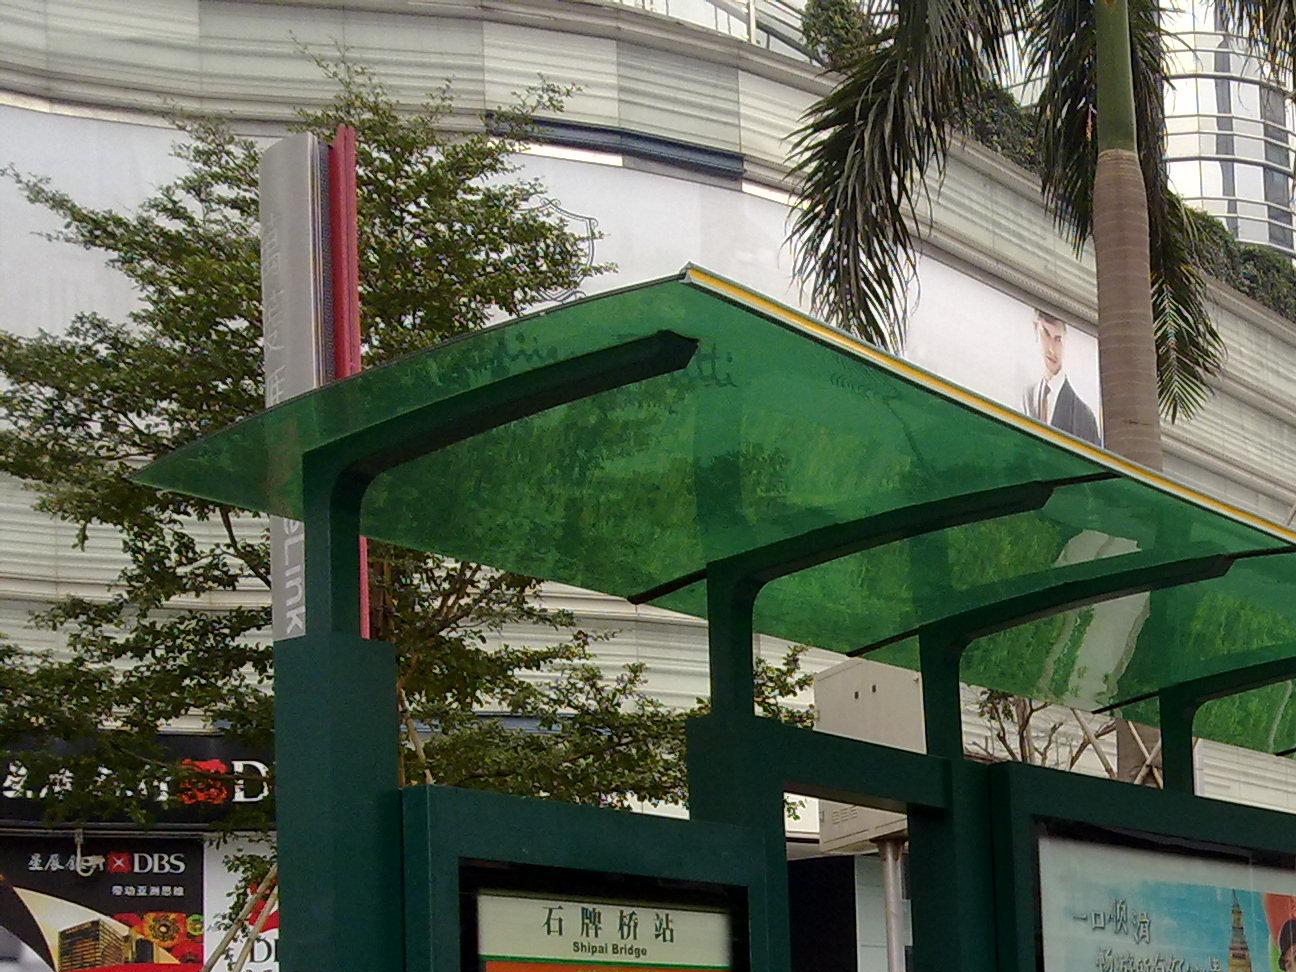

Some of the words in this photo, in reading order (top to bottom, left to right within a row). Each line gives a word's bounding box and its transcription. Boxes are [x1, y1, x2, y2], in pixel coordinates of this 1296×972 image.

[133, 853, 186, 874] DBS
[542, 905, 675, 943] 石牌桥站
[572, 940, 608, 956] Shipai
[612, 943, 647, 958] Bridge
